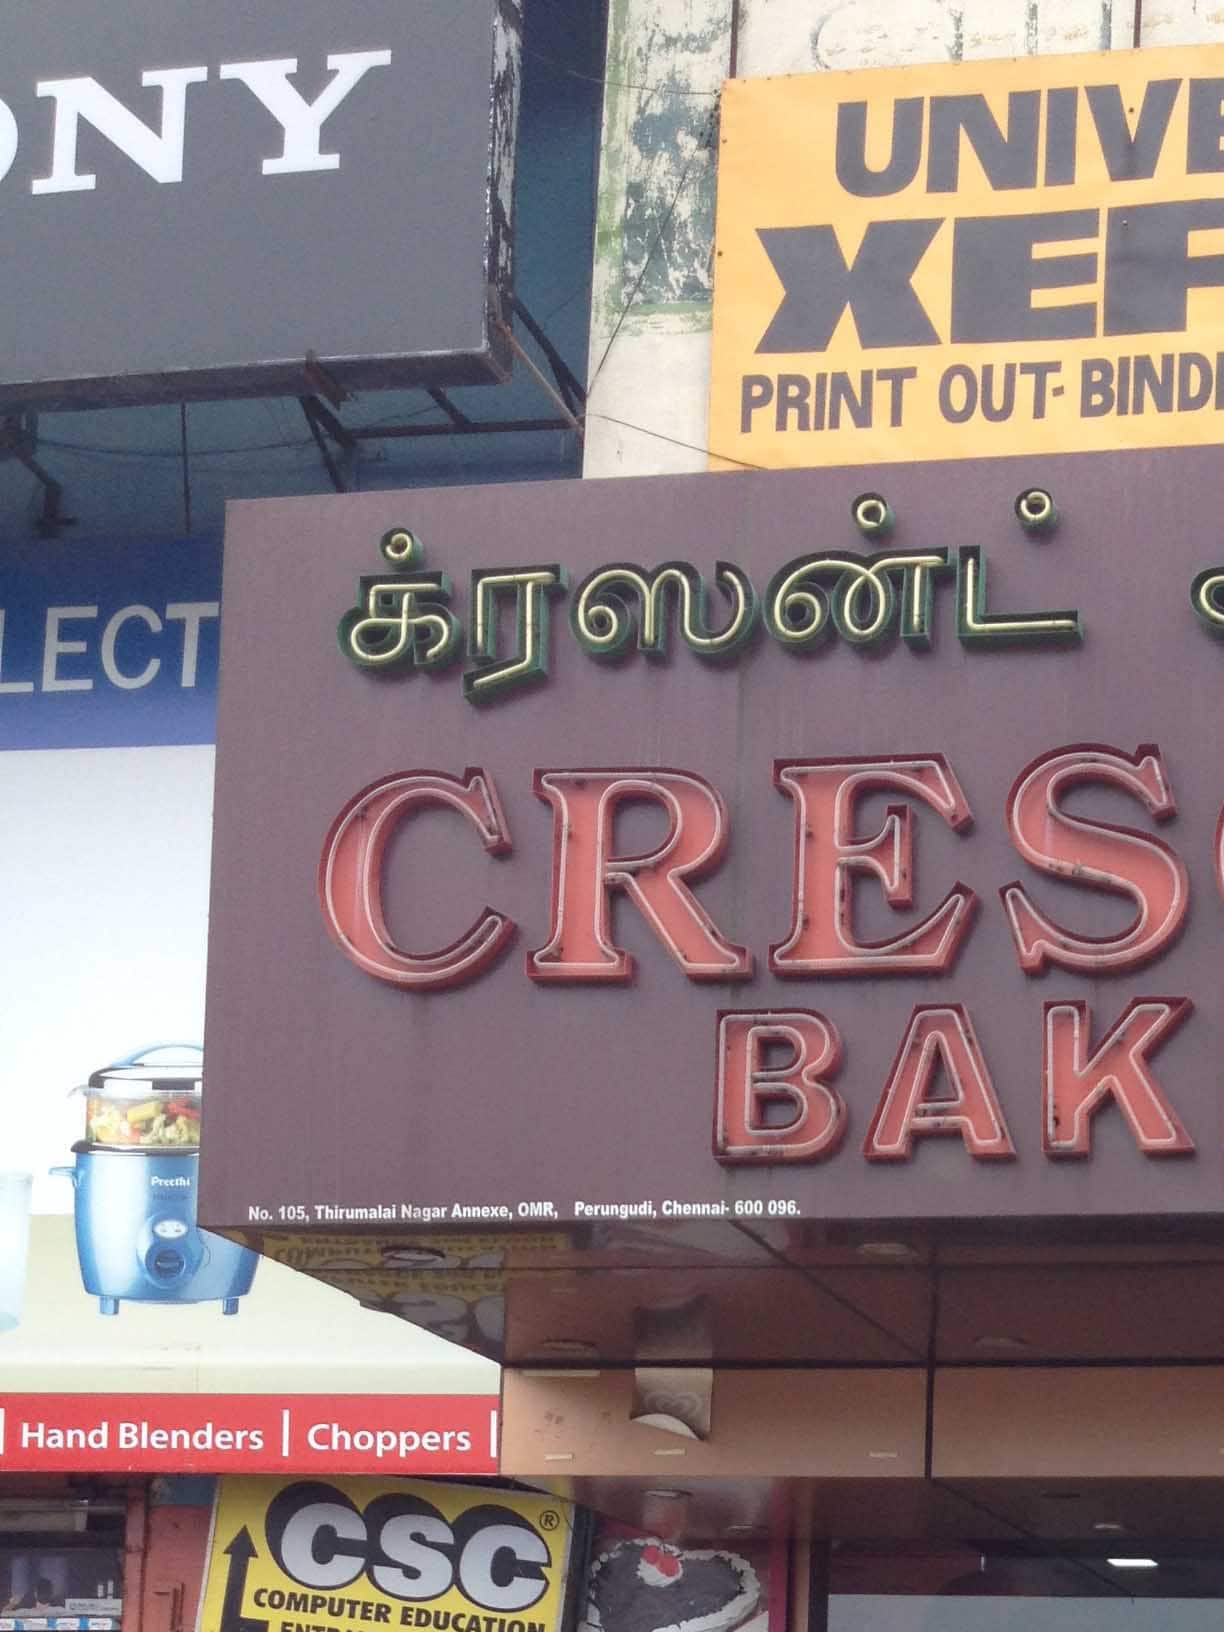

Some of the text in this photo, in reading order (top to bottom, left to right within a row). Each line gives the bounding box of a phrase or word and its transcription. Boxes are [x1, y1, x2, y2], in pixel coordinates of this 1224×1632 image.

[740, 366, 917, 433] PRINT
[248, 1205, 273, 1221] No.
[278, 1204, 310, 1222] 105,
[314, 1203, 397, 1220] Thirumalai
[401, 1203, 447, 1221] Nagar
[451, 1202, 513, 1220] Annexe,
[518, 1201, 559, 1219] OMR,
[574, 1200, 657, 1219] Perungudi,
[734, 1199, 763, 1215] 600
[767, 1199, 801, 1216] 096.
[20, 1420, 473, 1458] Hand Blenders Choppers
[266, 1482, 552, 1613] CSC
[253, 1586, 392, 1624] COMPUTER
